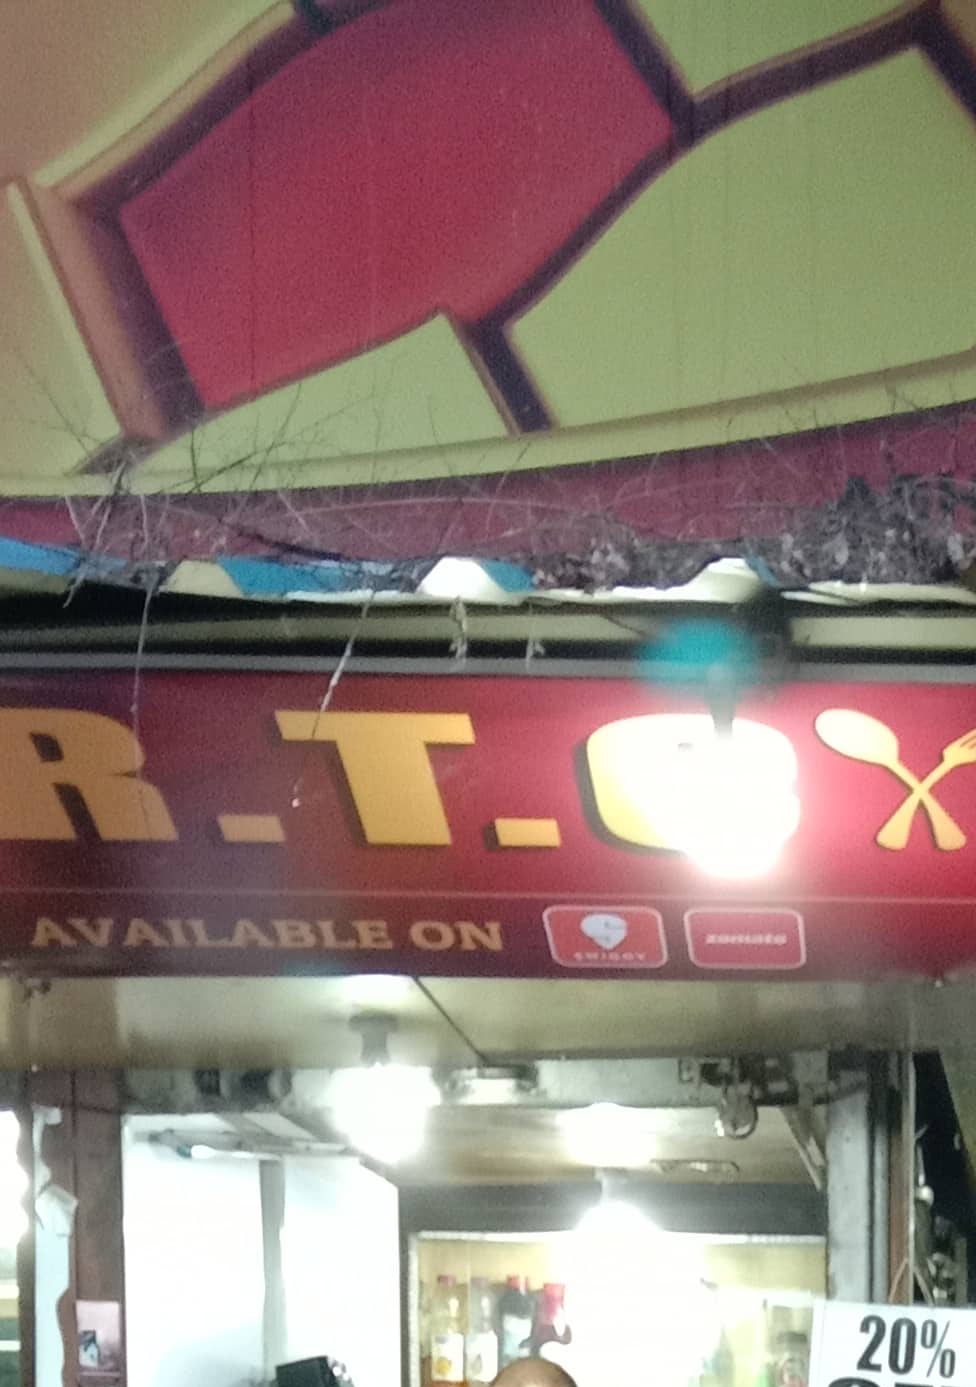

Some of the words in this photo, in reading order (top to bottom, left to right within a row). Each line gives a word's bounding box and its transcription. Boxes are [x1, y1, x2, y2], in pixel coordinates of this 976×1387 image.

[31, 917, 393, 951] AVAILABLE
[409, 920, 503, 951] ON
[857, 1314, 955, 1379] 20%
